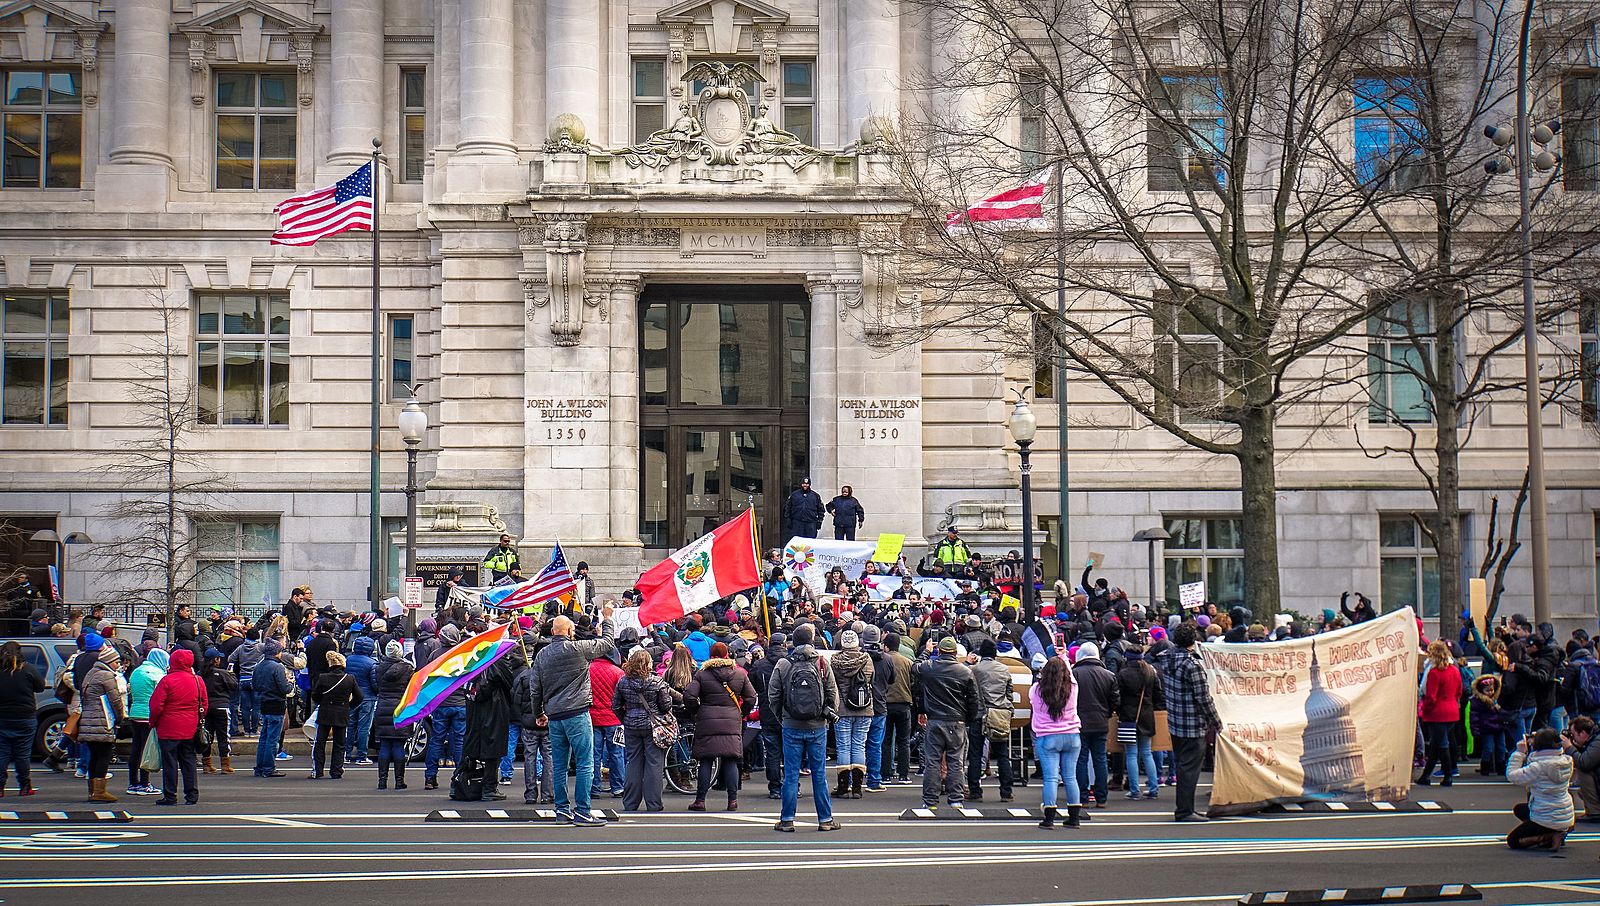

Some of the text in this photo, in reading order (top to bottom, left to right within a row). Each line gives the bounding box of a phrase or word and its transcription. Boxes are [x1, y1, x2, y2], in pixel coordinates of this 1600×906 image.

[689, 234, 759, 249] MCMIV
[526, 399, 607, 409] JOHN A. WILSON
[839, 399, 920, 409] JOHN A. WILSON
[540, 409, 593, 419] BUILDING
[853, 409, 905, 419] BUILDING
[547, 428, 586, 440] 1350
[860, 428, 899, 440] 1350
[818, 553, 840, 564] many
[993, 564, 1012, 580] NO
[1201, 630, 1405, 673] IMMIGRANTS WORK FOR
[1215, 672, 1297, 696] AMERICA'S
[1226, 721, 1277, 744] FMLN
